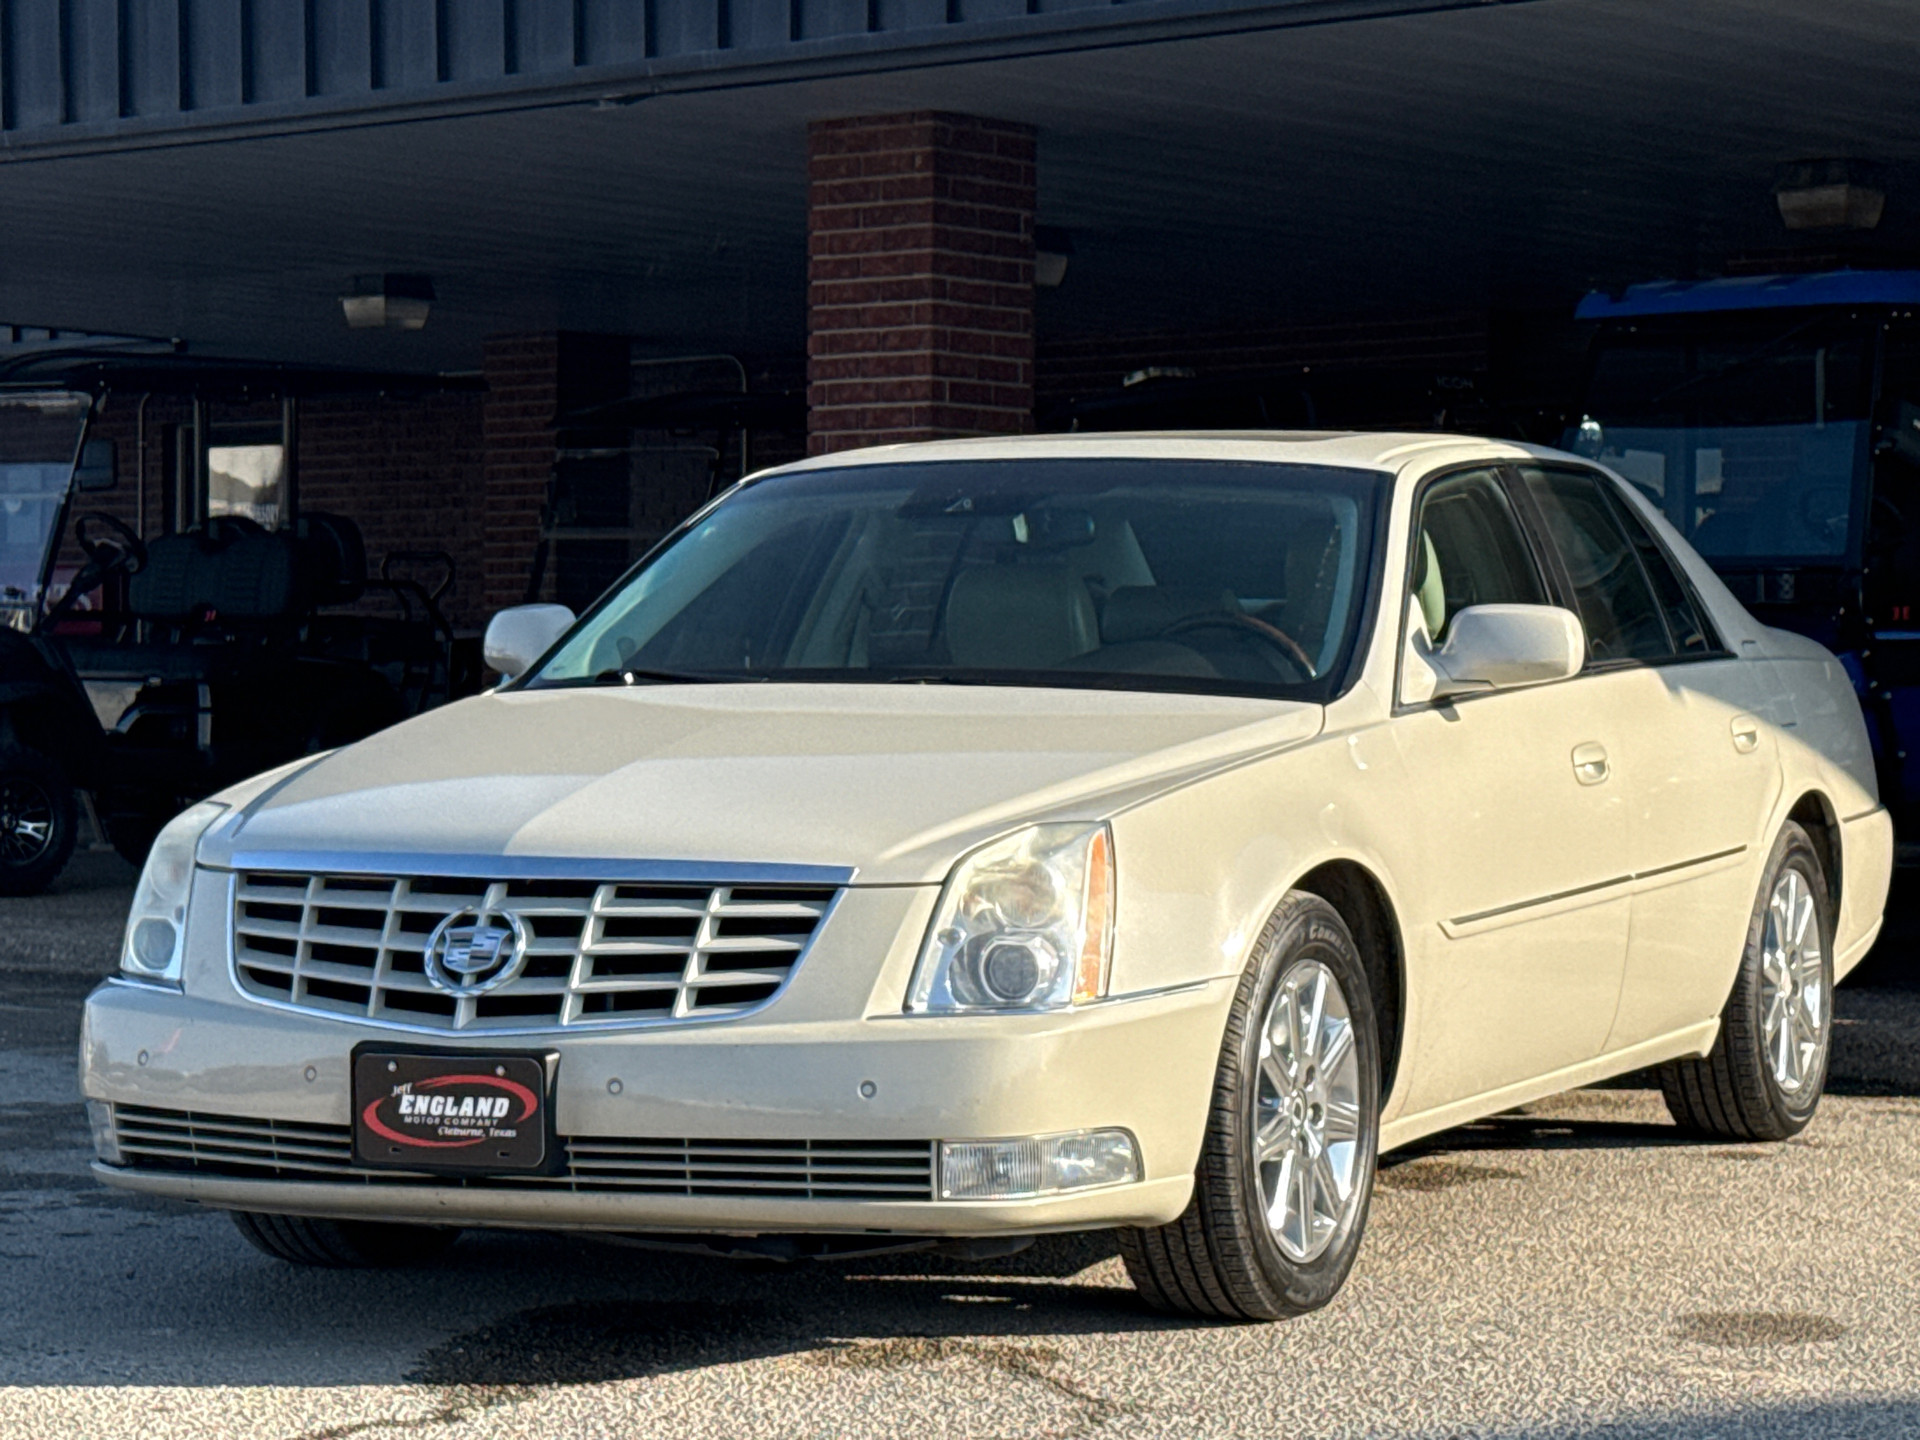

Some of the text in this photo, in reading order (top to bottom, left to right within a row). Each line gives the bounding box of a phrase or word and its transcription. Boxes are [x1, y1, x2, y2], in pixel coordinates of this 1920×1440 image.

[399, 1095, 510, 1118] ENGLAND
[404, 1116, 499, 1127] MOTOR COMPANY
[489, 1127, 517, 1138] Texas
